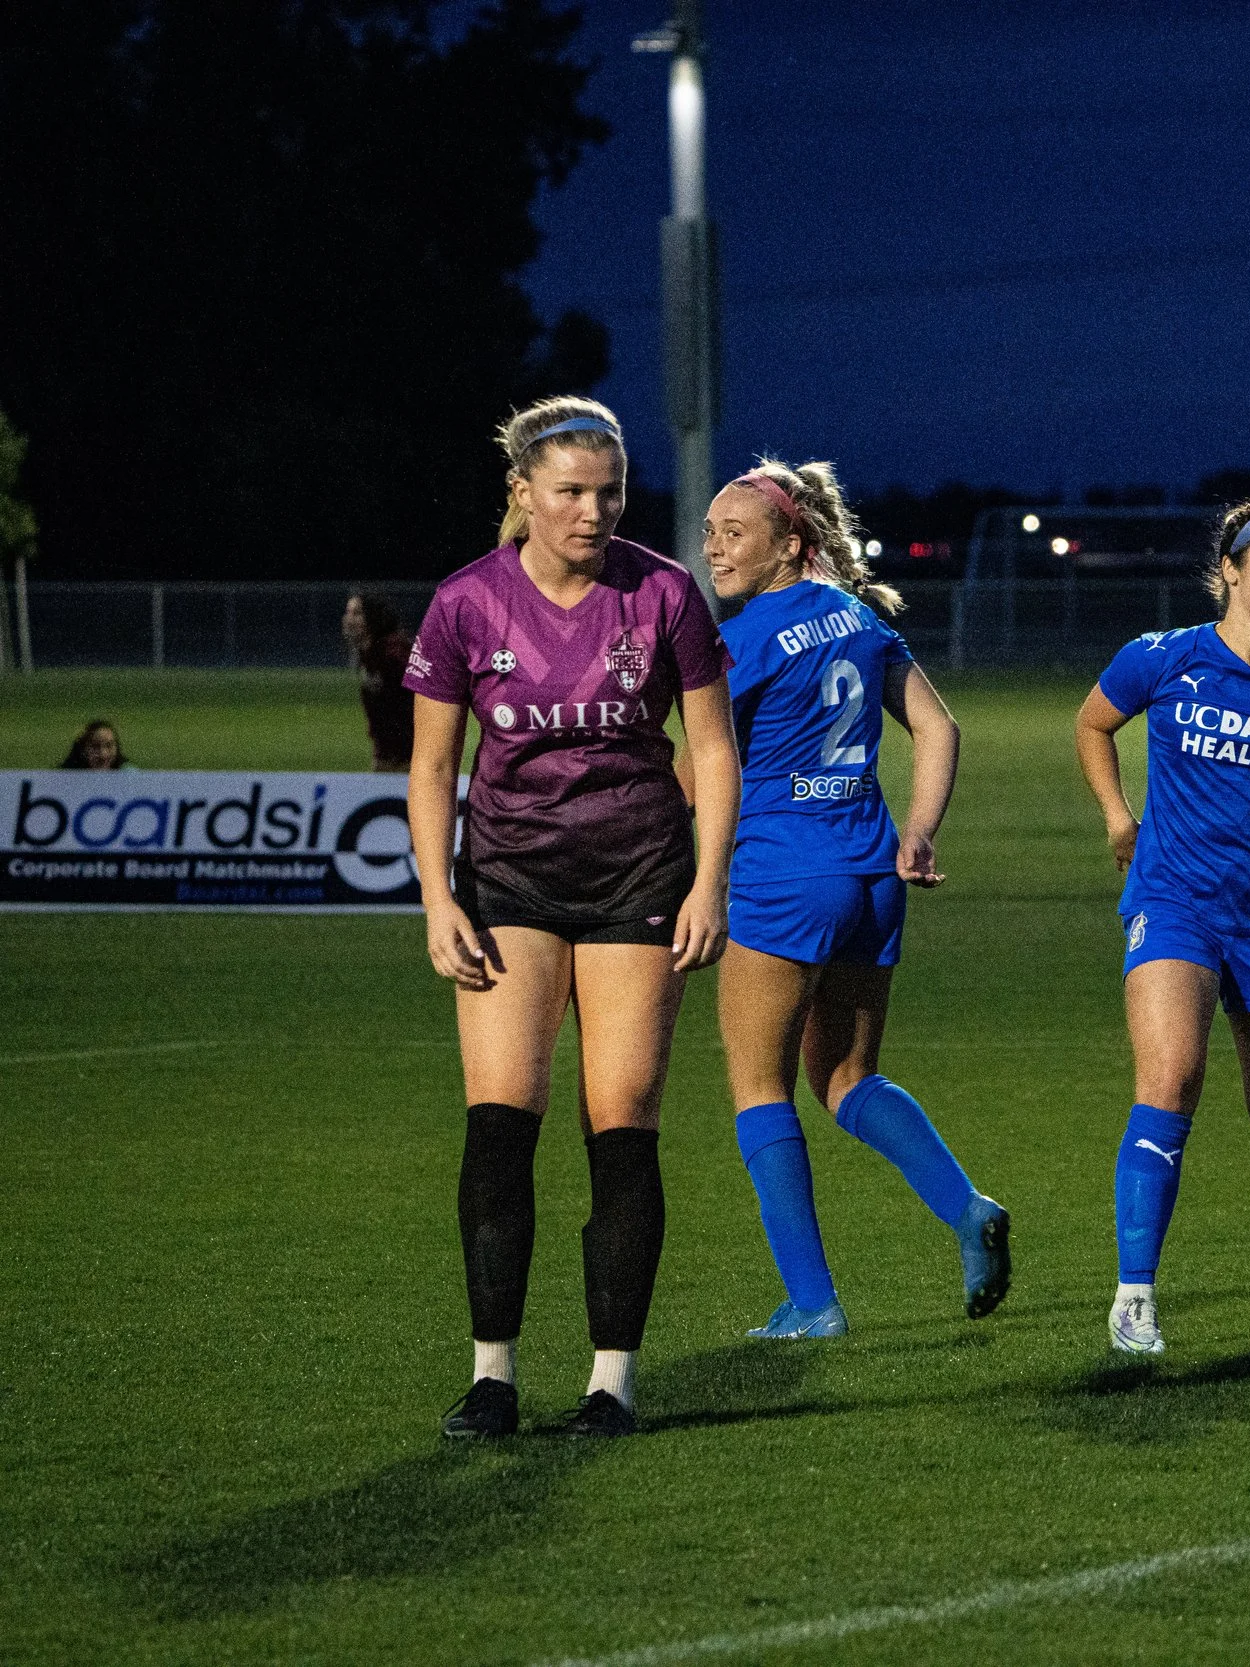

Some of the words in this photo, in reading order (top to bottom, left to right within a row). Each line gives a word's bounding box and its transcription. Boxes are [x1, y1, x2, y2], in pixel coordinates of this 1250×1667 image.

[526, 699, 651, 730] MIRA
[820, 659, 866, 768] 2
[13, 779, 328, 850] boardsi
[8, 858, 118, 880] Corporate
[124, 859, 190, 879] Board
[194, 860, 329, 880] Matchmaker
